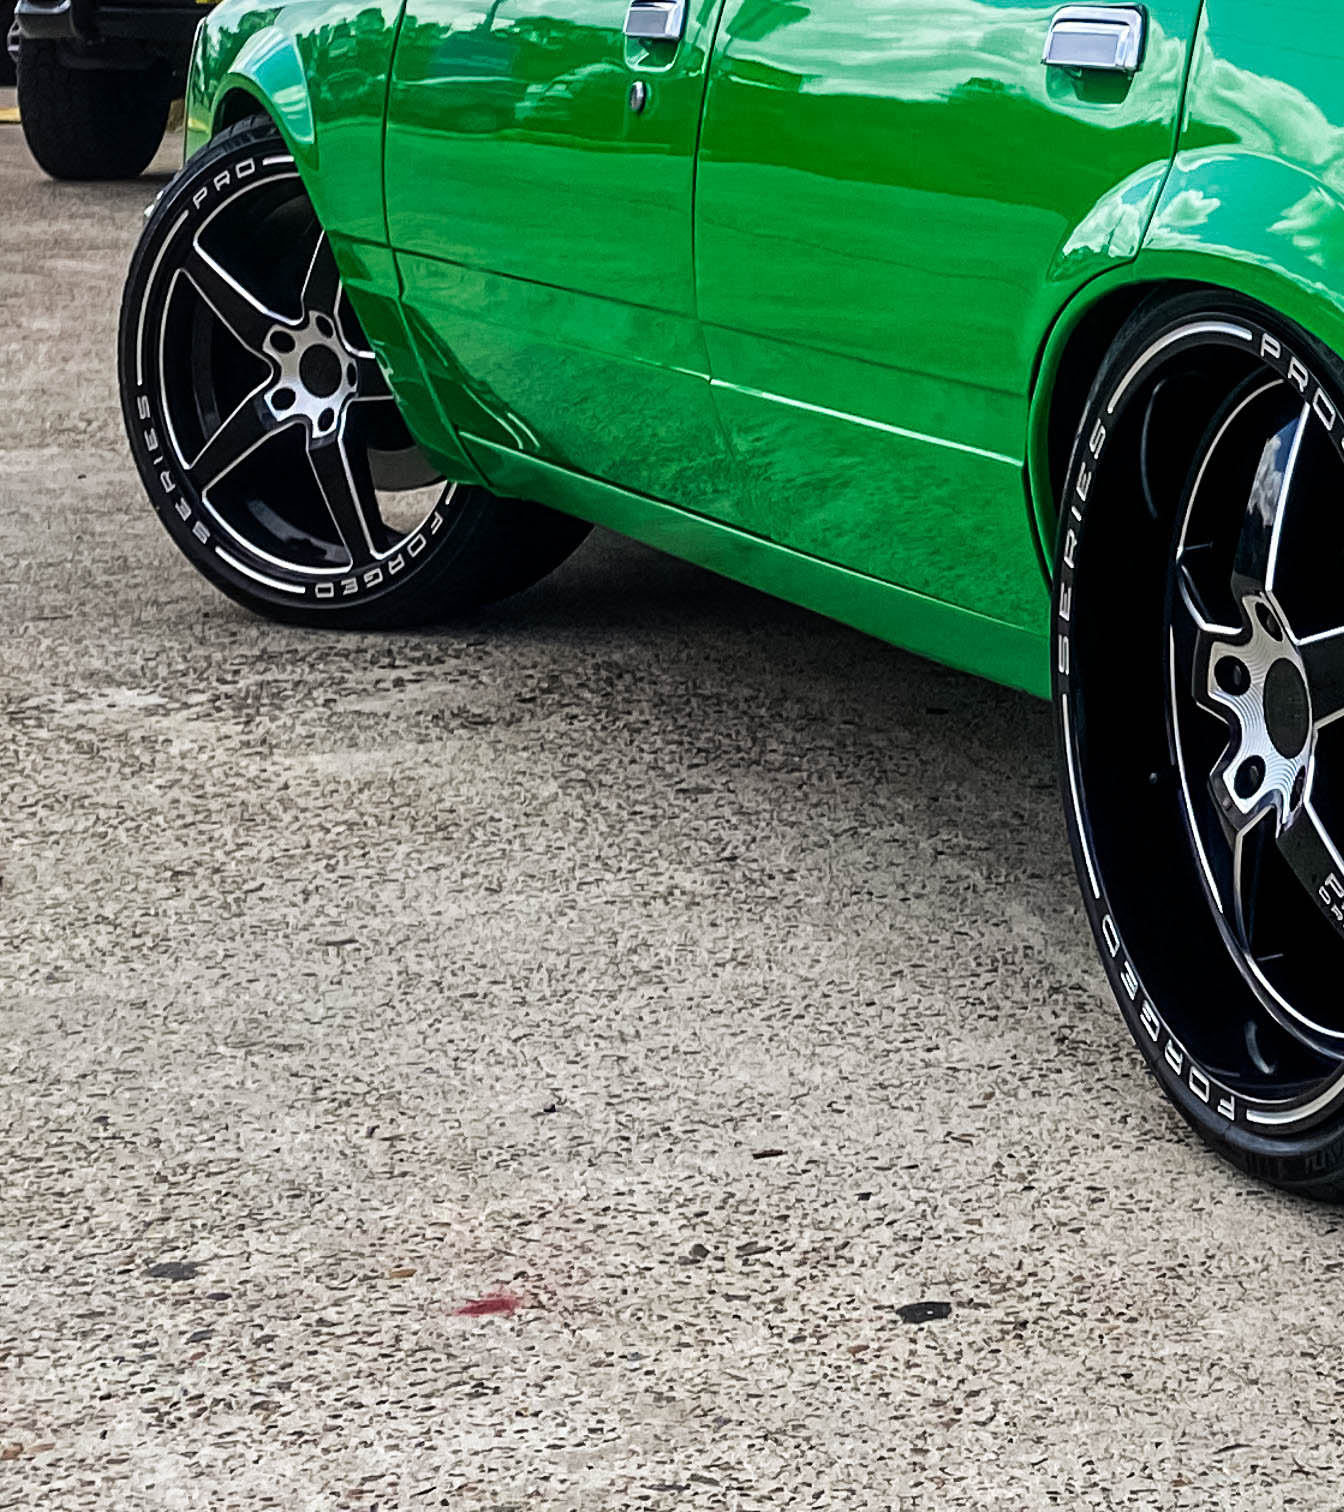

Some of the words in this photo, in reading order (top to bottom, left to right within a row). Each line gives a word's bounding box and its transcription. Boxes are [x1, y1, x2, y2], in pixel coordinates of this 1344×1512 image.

[192, 158, 256, 210] PRO
[1260, 333, 1336, 431] PRO
[138, 395, 210, 545] SERIES
[315, 511, 444, 598] FORGED
[1058, 418, 1106, 675] SERIES
[1102, 915, 1236, 1120] FORGED
